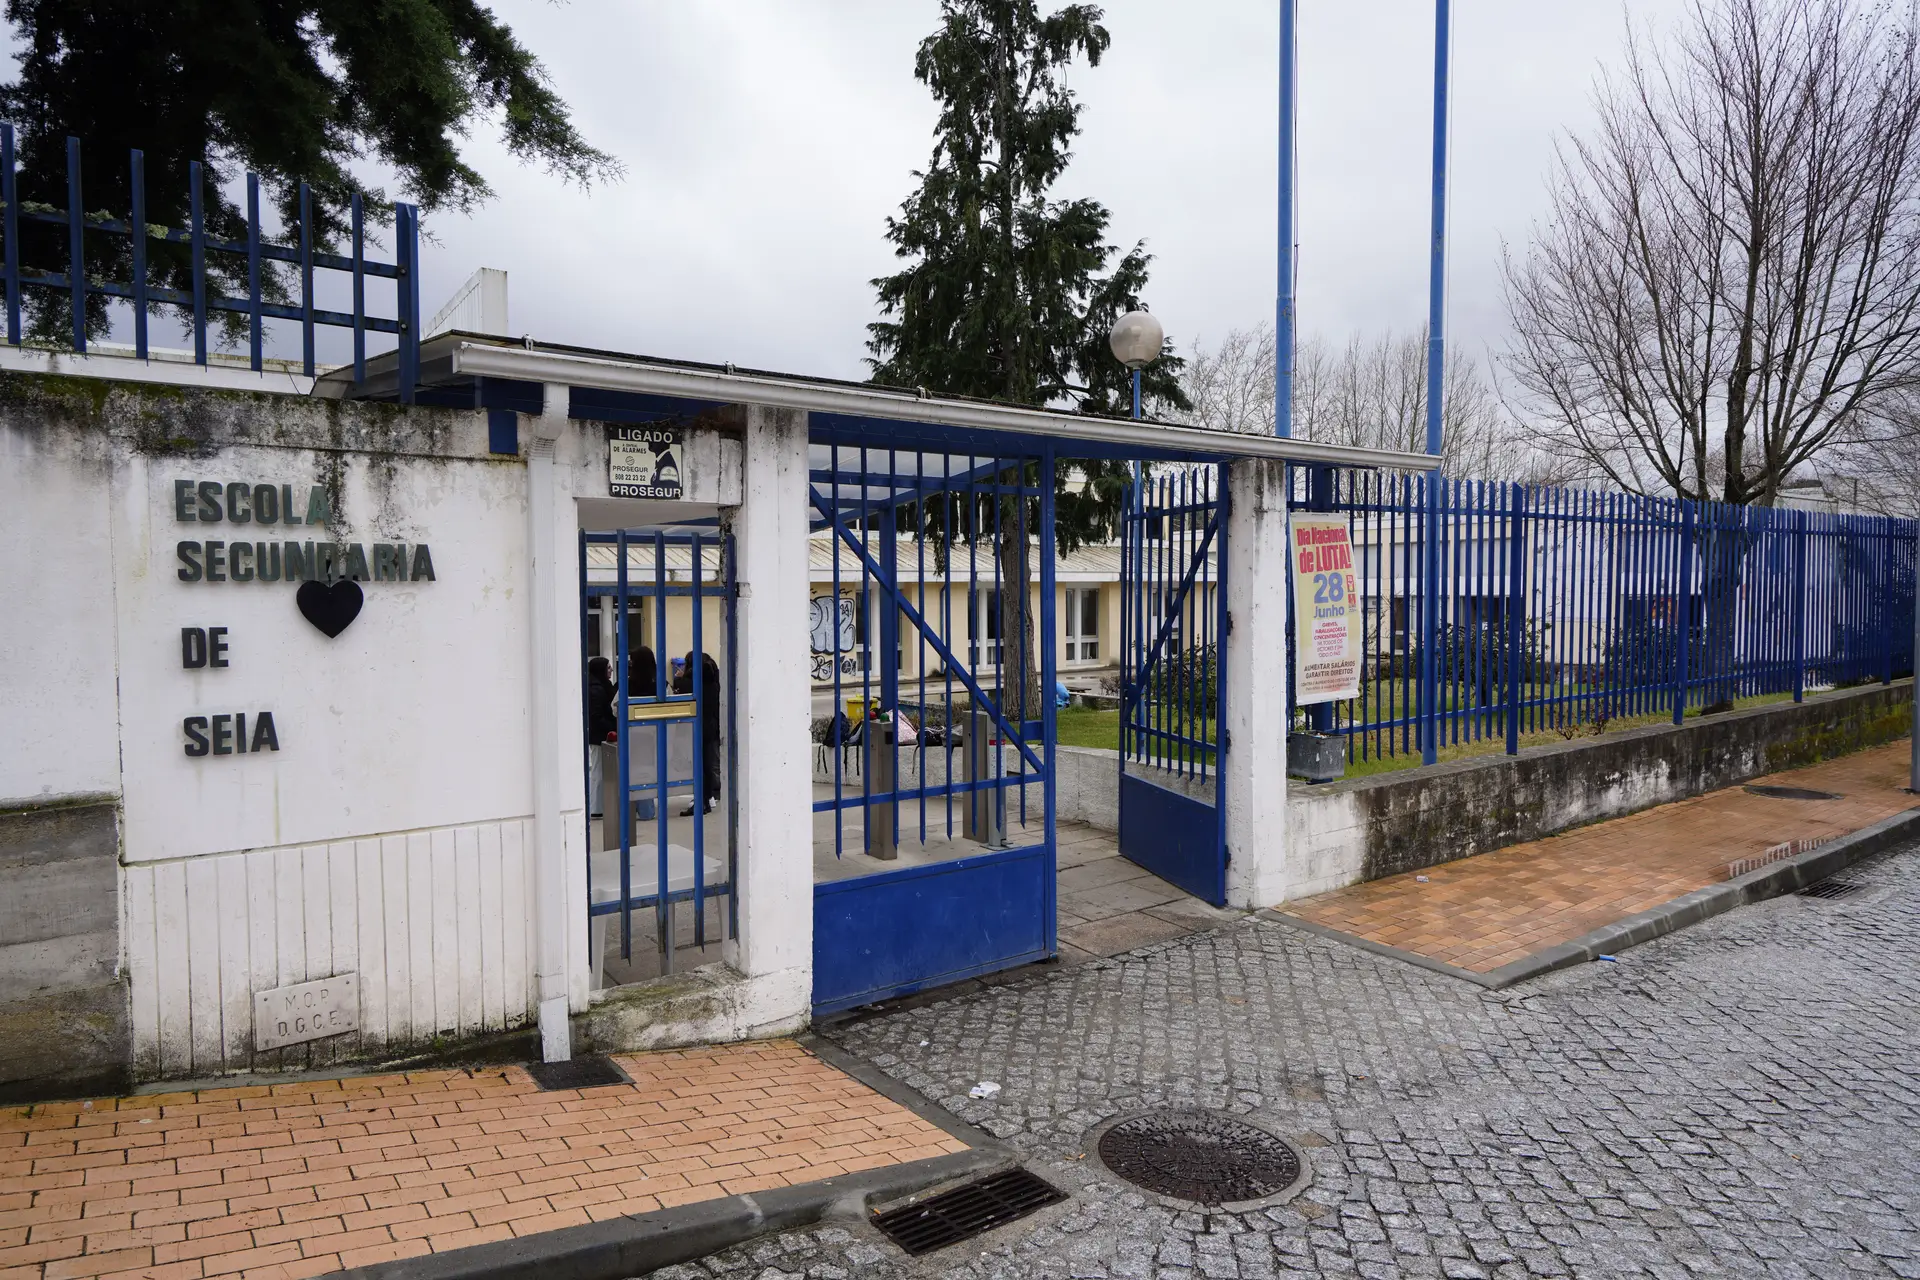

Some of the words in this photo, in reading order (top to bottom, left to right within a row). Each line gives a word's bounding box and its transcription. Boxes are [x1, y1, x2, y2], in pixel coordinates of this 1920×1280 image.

[618, 428, 673, 443] LIGADO
[612, 465, 649, 473] PROSEGUR
[174, 480, 332, 526] ESCOLA
[612, 485, 681, 498] PROSEGUR
[1296, 528, 1311, 547] Dia
[1311, 526, 1348, 545] Nacional
[177, 541, 436, 582] SECUNDARIA
[1299, 548, 1314, 574] de
[1315, 544, 1352, 572] LUTA!
[1313, 572, 1344, 604] 28
[181, 627, 229, 669] DE
[1304, 662, 1330, 671] AUMENTAR
[1331, 660, 1355, 669] SALÁRIOS
[1305, 671, 1329, 679] GARANTIR
[1331, 668, 1353, 676] DIREITOS
[183, 712, 280, 757] SEIA
